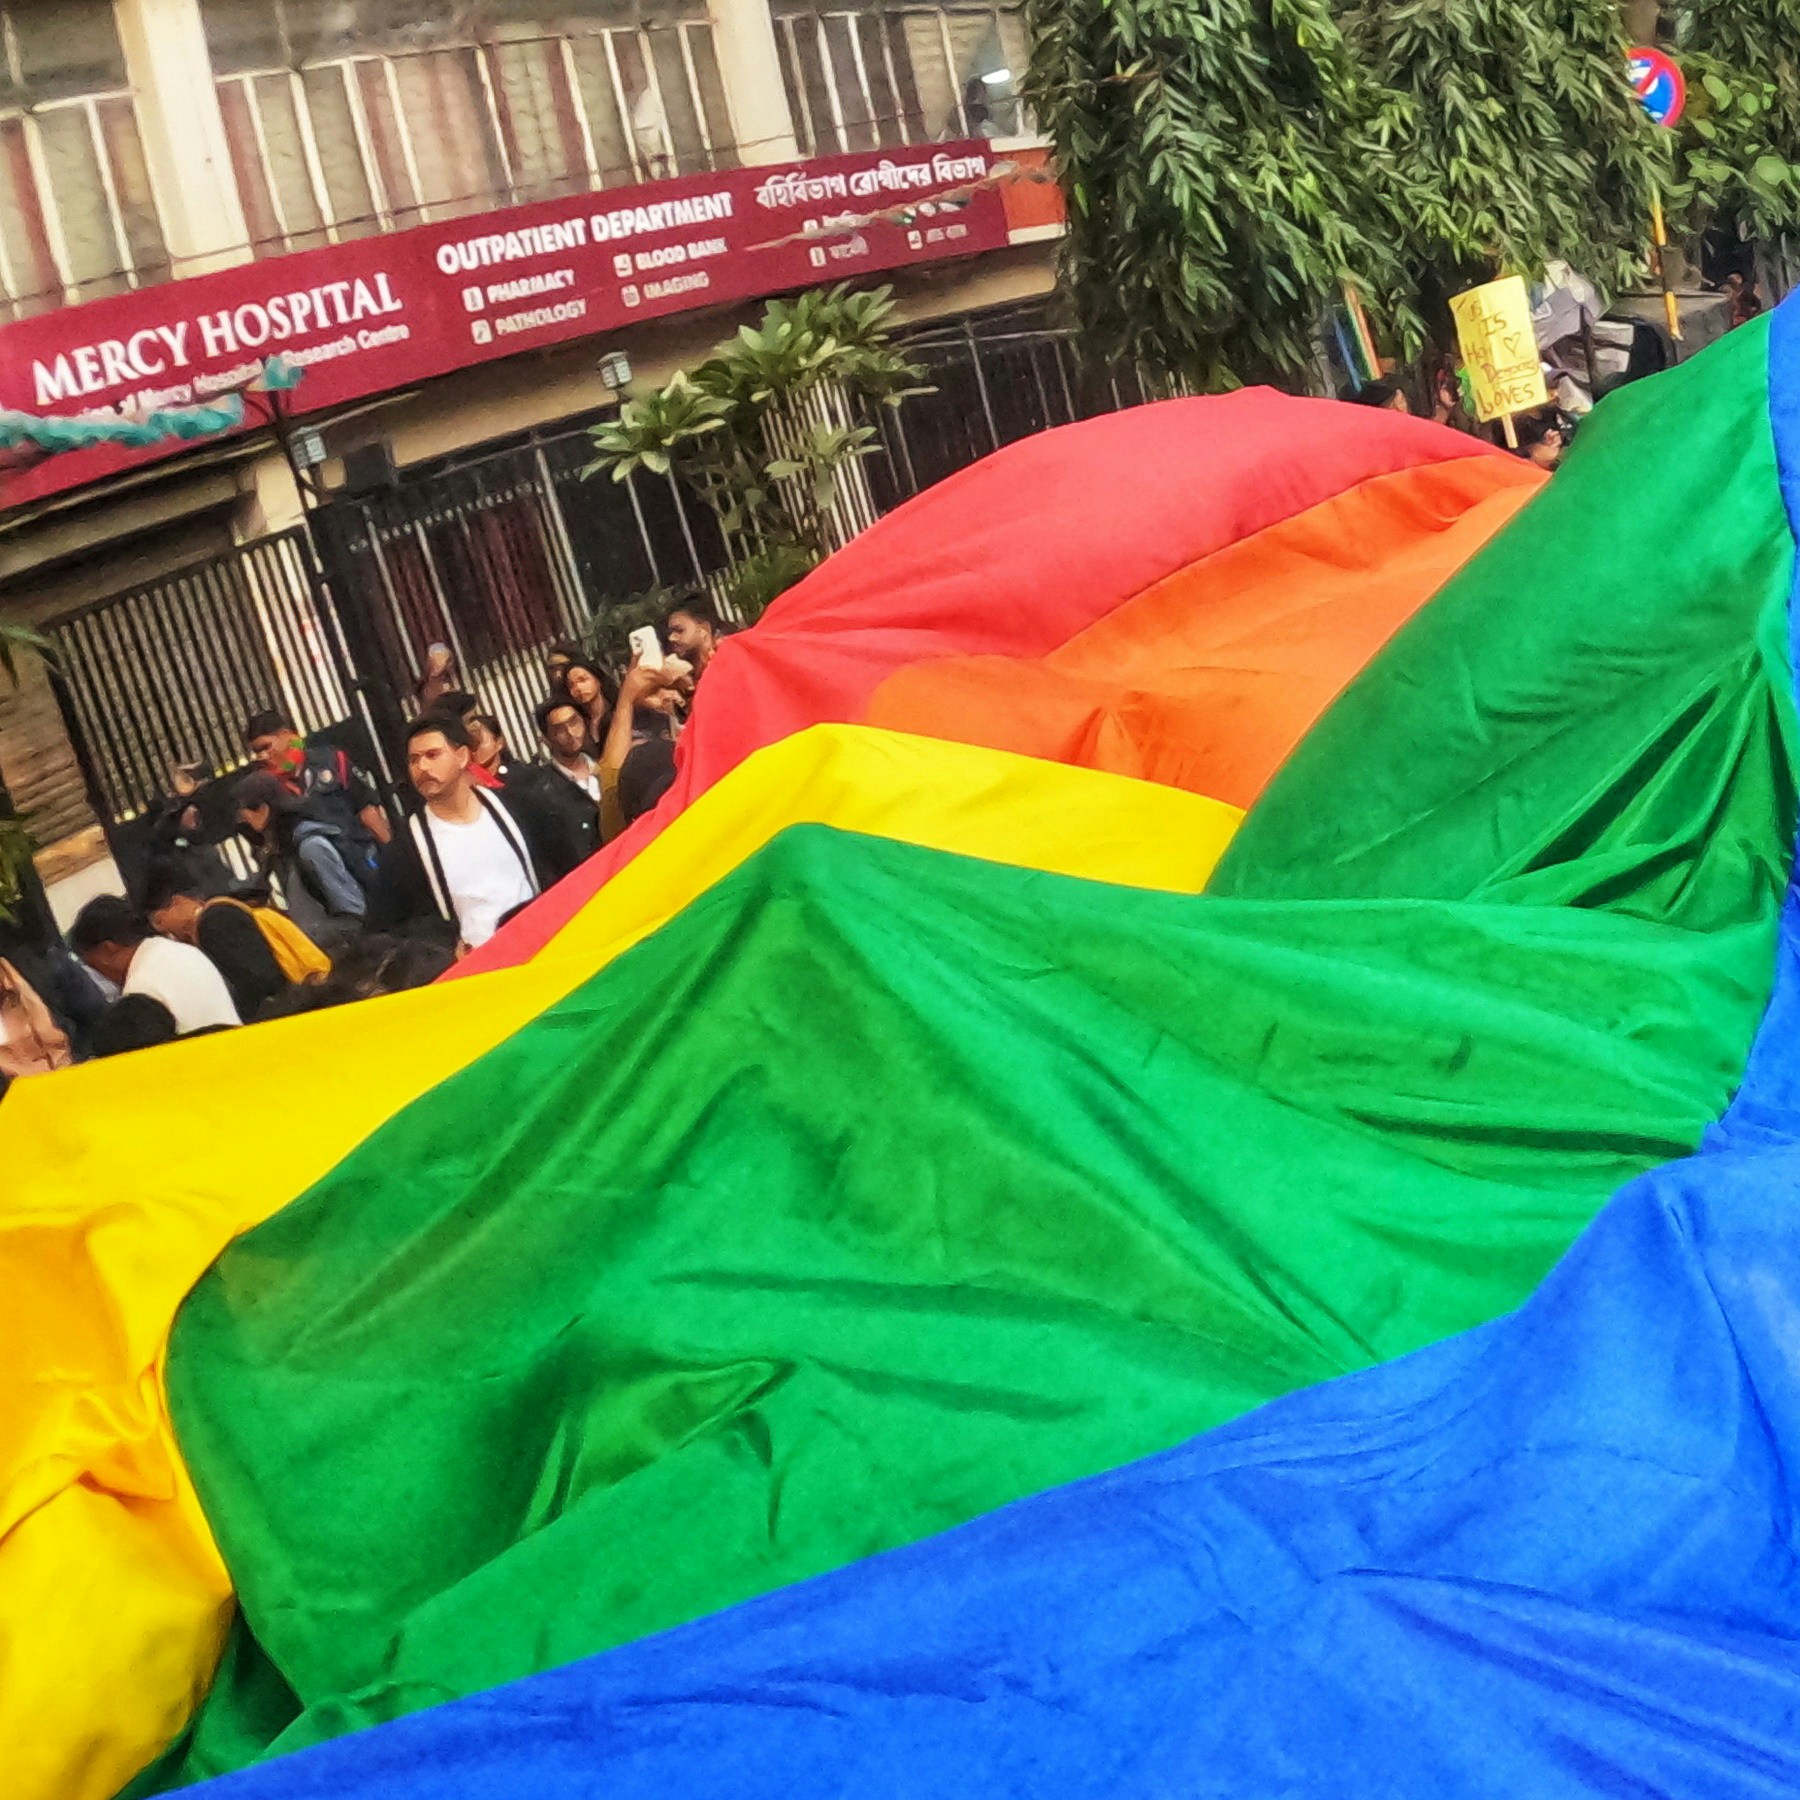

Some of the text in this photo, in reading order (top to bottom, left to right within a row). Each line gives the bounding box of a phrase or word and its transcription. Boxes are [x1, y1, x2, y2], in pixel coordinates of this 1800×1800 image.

[436, 191, 734, 275] OUTPATIENT DEPARTMENT
[635, 237, 728, 271] BLOOD BANK
[487, 269, 575, 303] PHARMACY
[495, 298, 587, 335] PATHOLOGY
[32, 272, 403, 406] MERCY HOSPITAL
